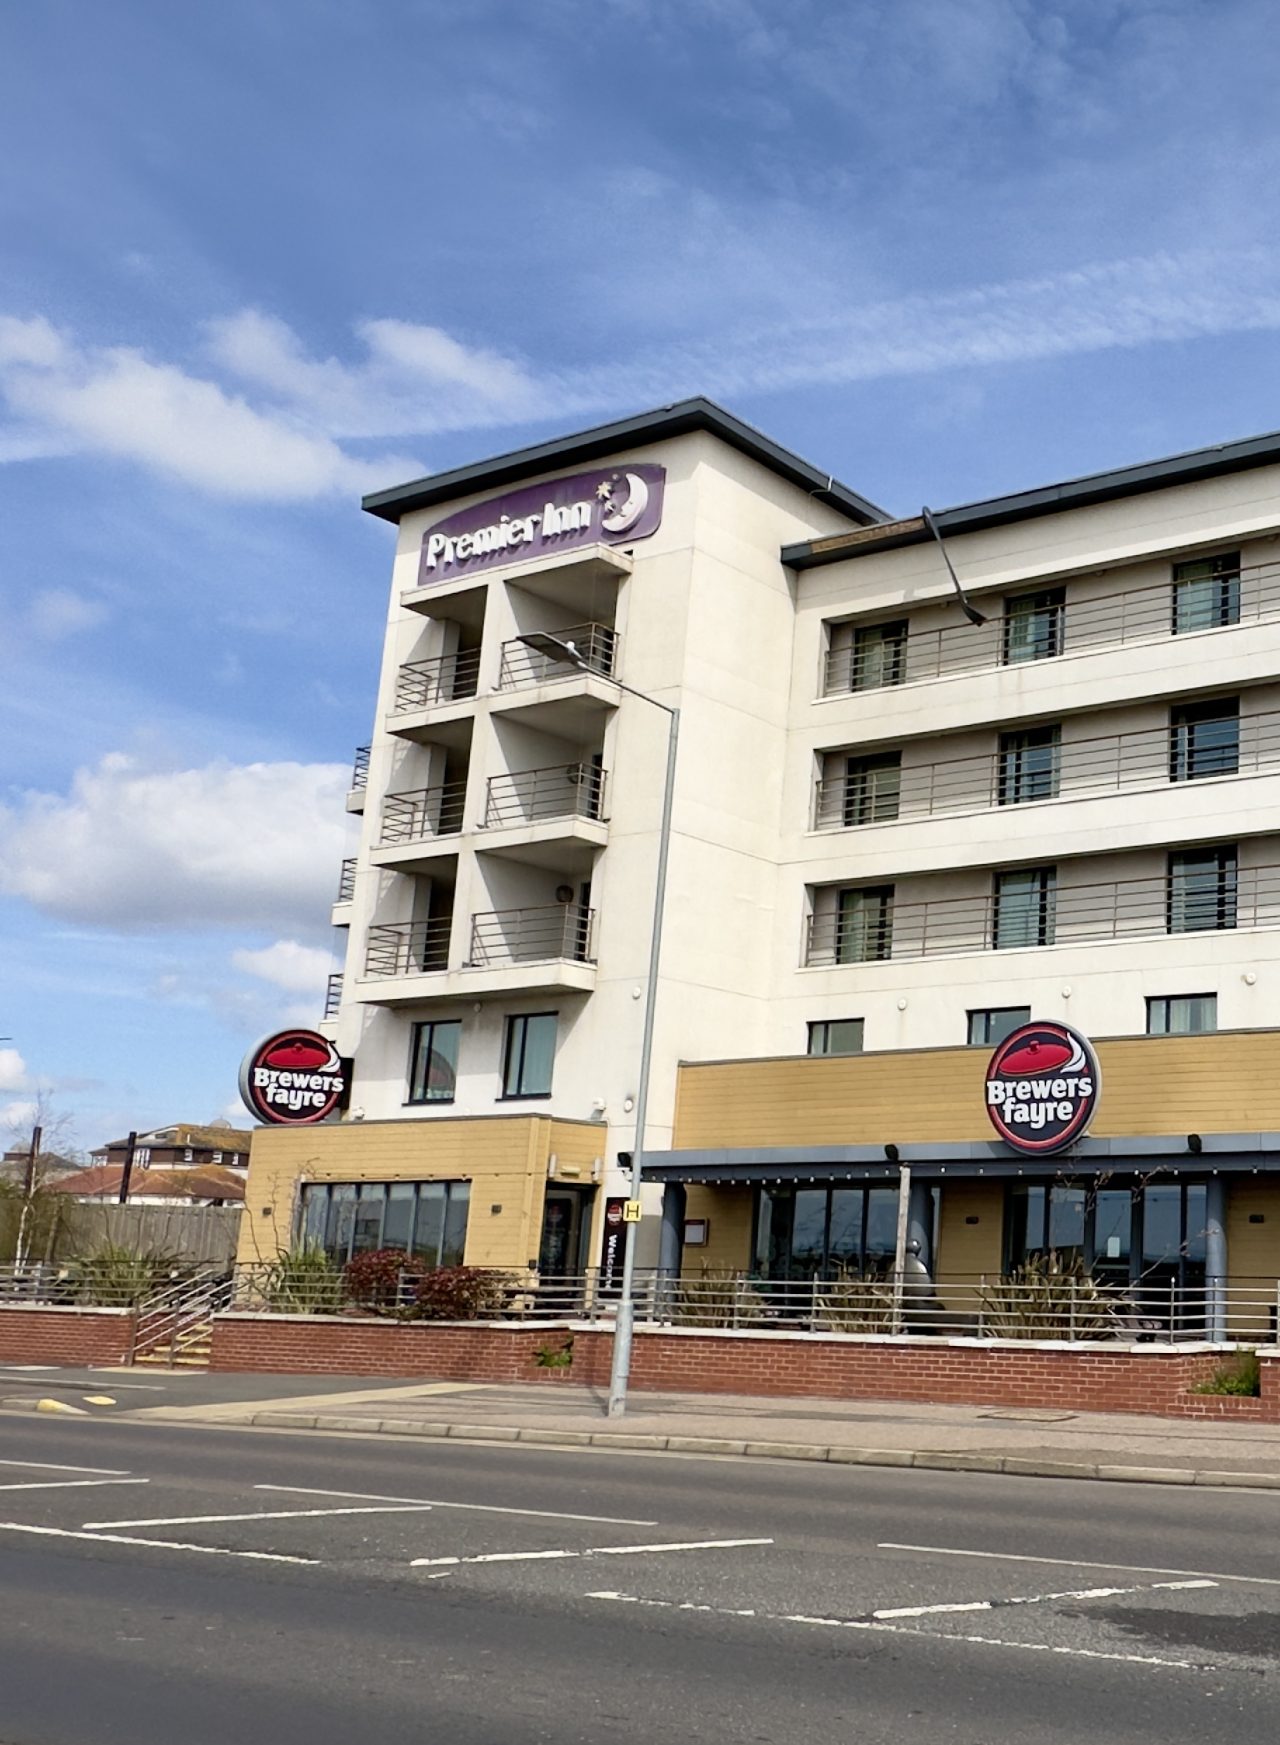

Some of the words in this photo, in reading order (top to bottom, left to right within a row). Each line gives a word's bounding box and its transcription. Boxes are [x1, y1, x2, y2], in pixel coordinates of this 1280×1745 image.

[426, 514, 541, 567] Premier
[542, 502, 591, 537] Inn
[254, 1067, 344, 1092] Brewers
[987, 1077, 1093, 1105] Brewers
[266, 1083, 326, 1110] fayre
[1002, 1097, 1073, 1129] fayre
[626, 1204, 639, 1219] H
